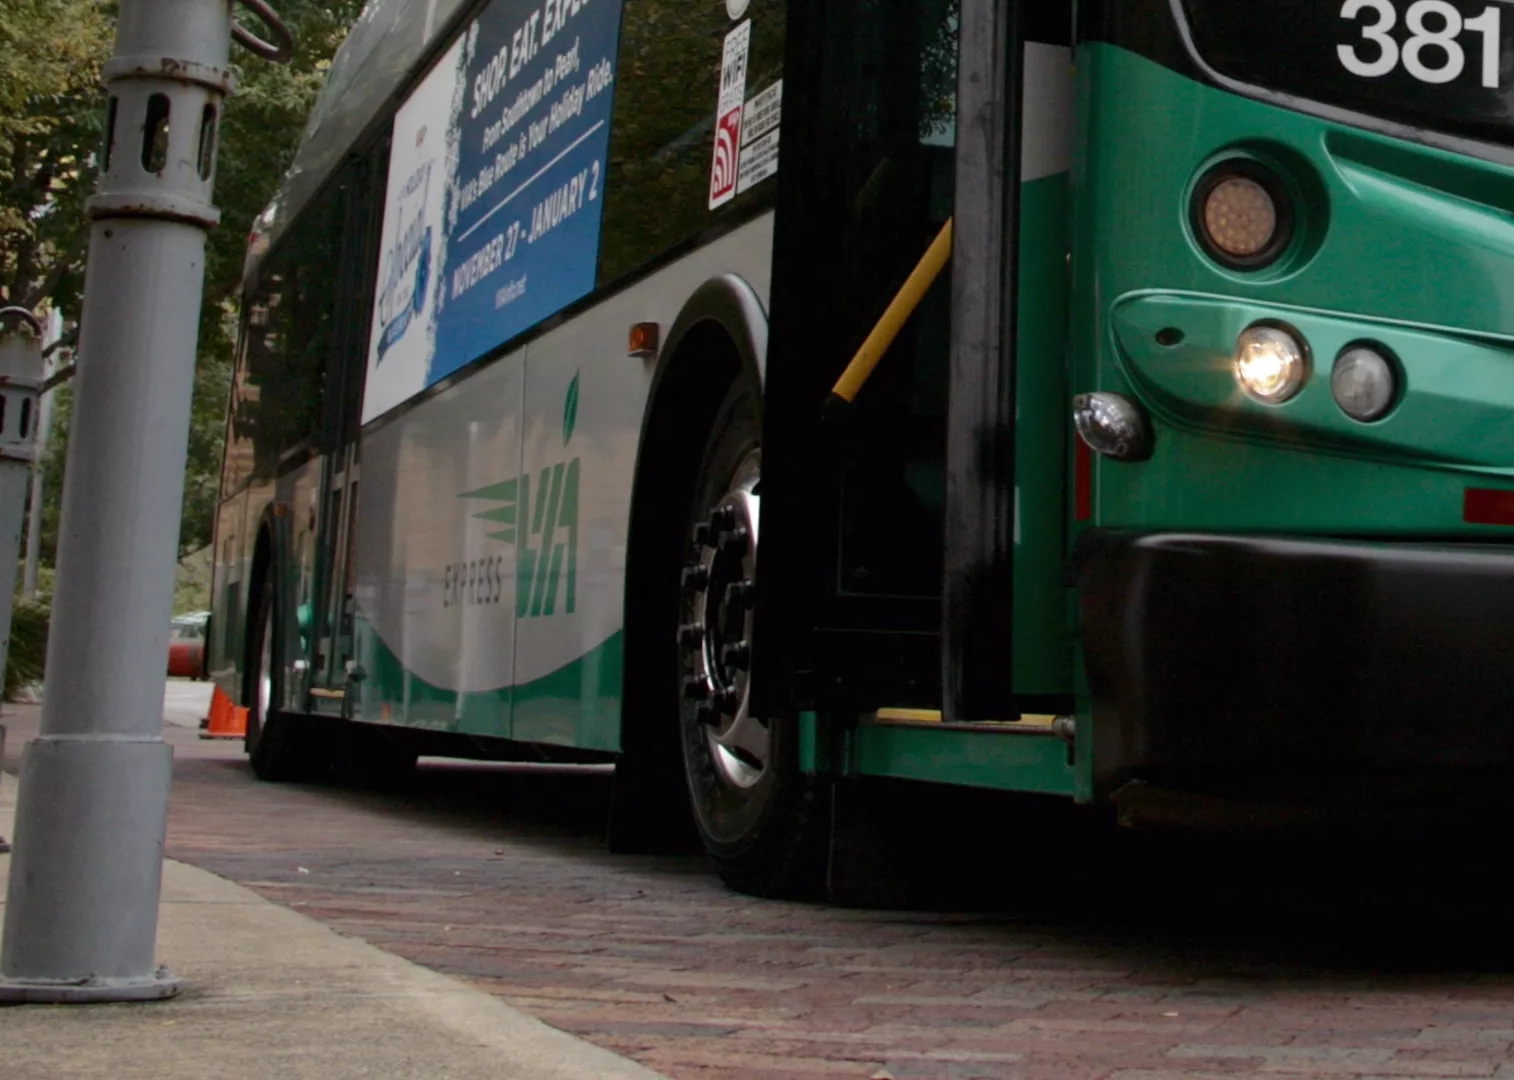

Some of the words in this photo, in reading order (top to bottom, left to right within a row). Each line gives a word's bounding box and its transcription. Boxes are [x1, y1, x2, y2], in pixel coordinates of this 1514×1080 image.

[471, 46, 508, 119] SHOP.
[509, 9, 540, 80] EAT.
[494, 143, 518, 182] Route
[528, 117, 548, 152] Your
[548, 83, 585, 135] Holiday
[585, 57, 613, 102] Ride.
[452, 233, 504, 301] NOVEMBER
[504, 220, 520, 262] 27
[527, 168, 587, 244] JANUARY
[588, 159, 600, 201] 2
[443, 556, 503, 608] EXPRESS
